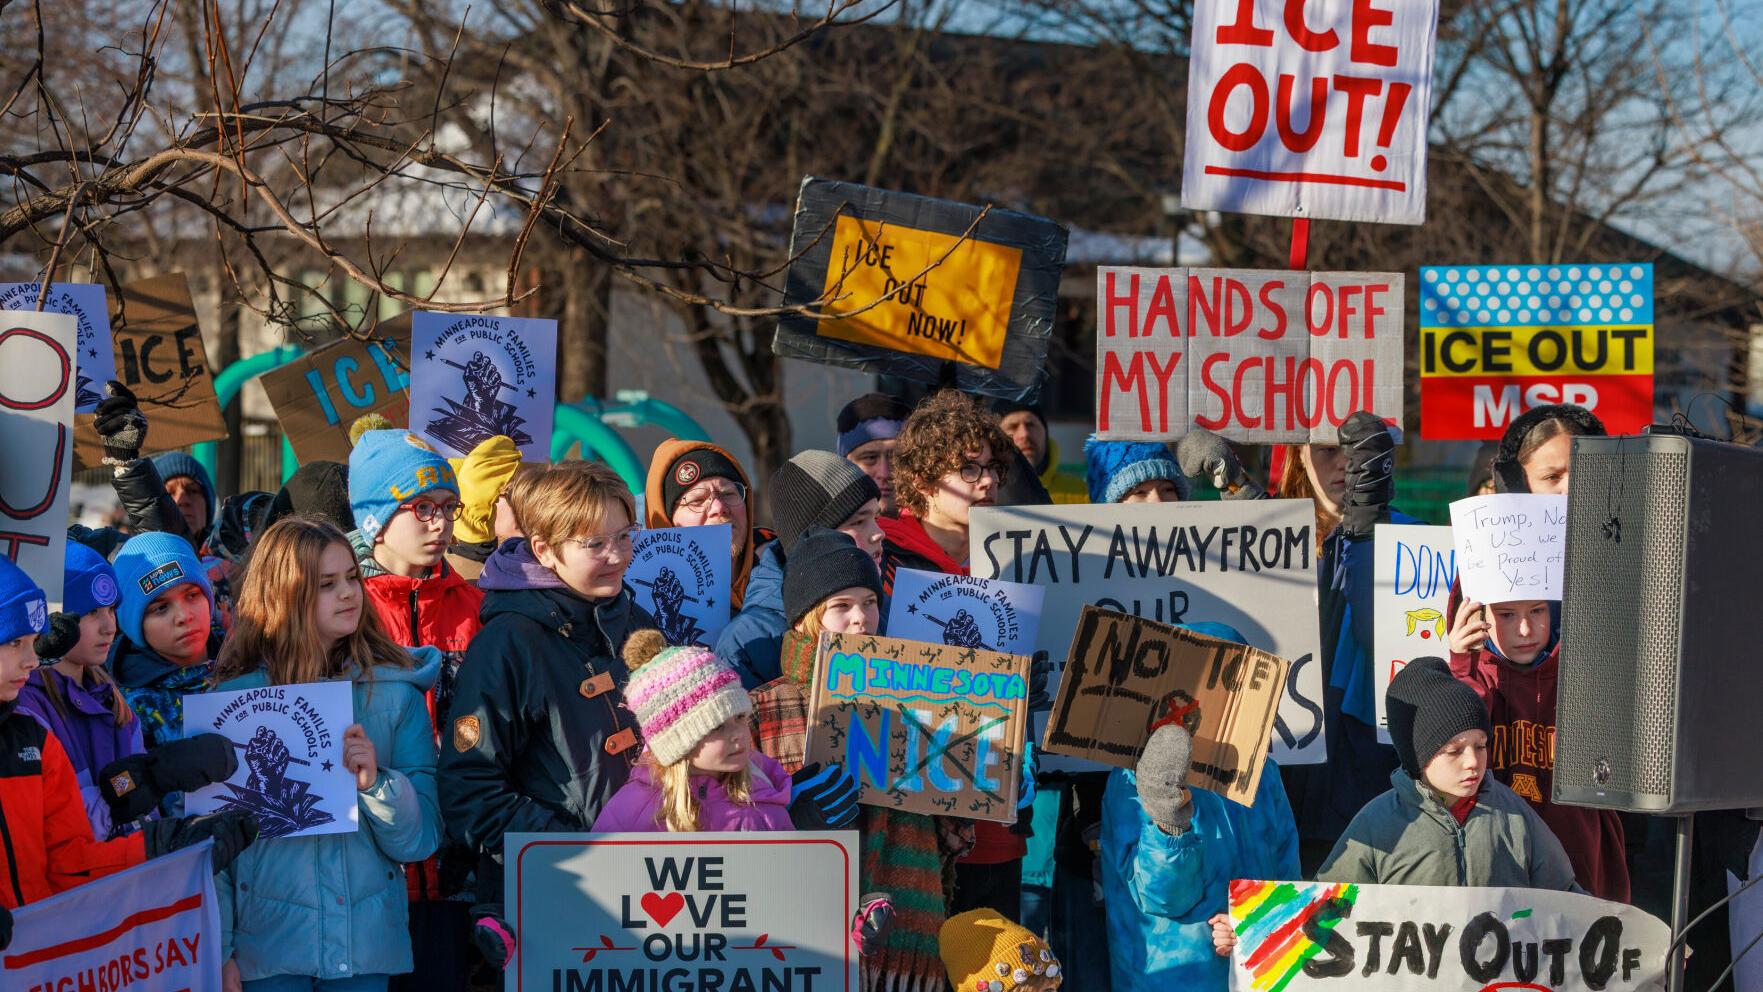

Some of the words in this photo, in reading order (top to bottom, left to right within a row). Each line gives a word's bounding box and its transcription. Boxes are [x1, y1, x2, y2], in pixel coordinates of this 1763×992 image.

[1207, 62, 1412, 172] OUT!
[855, 239, 894, 268] ICE
[884, 277, 927, 308] OUT
[1105, 272, 1288, 341] HANDS
[1304, 282, 1389, 339] OFF
[434, 317, 501, 350] MINNEAPOLIS
[506, 329, 536, 379] FAMILIES
[907, 311, 967, 345] NOW!
[1424, 331, 1513, 373] ICE
[1528, 330, 1647, 371] OUT
[470, 330, 503, 344] PUBLIC
[503, 342, 526, 386] SCHOOLS
[1100, 351, 1182, 433] MY
[1194, 352, 1396, 431] SCHOOL
[1464, 505, 1533, 530] Trump,
[655, 545, 684, 557] PUBLIC
[685, 554, 705, 596] SCHOOLS
[688, 540, 714, 588] FAMILIES
[983, 525, 1093, 583] STAY
[1502, 566, 1550, 593] Yes!
[919, 575, 989, 604] MINNEAPOLIS
[994, 590, 1019, 641] FAMILIES
[956, 587, 988, 604] PUBLIC
[989, 602, 1010, 648] SCHOOLS
[827, 651, 1027, 700] MINNESOTA
[1093, 620, 1169, 687] NO
[212, 688, 286, 730] MINNEAPOLIS
[293, 696, 332, 749] FAMILIES
[252, 702, 290, 715] PUBLIC
[291, 711, 318, 758] SCHOOLS
[846, 707, 1005, 793] NICE
[644, 856, 724, 891] WE
[154, 933, 200, 974] SAY
[643, 933, 727, 962] OUR
[1302, 896, 1455, 980] STAY
[1459, 910, 1573, 986] OUT
[1579, 915, 1641, 991] OF
[552, 967, 821, 992] IMMIGRANT
